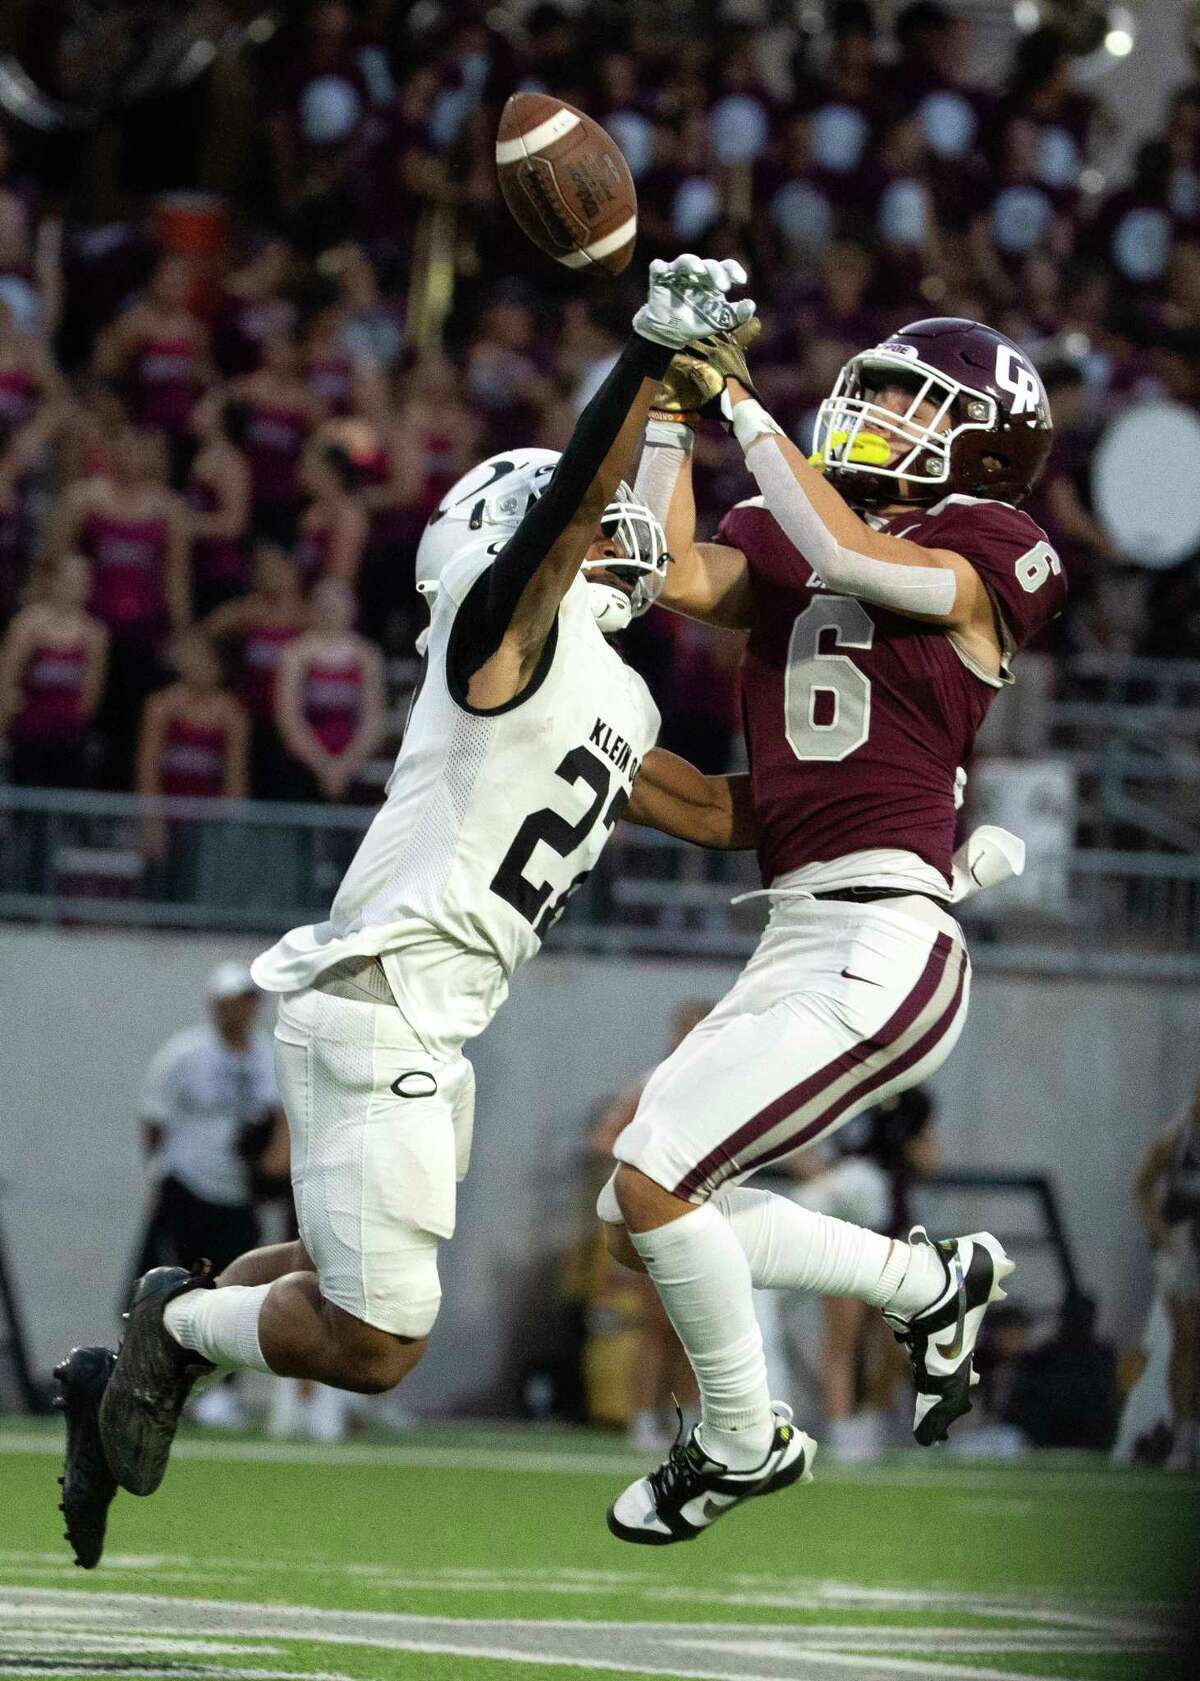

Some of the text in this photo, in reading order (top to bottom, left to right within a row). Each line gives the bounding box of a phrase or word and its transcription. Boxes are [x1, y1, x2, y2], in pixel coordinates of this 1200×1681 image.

[1014, 540, 1061, 593] 6
[784, 594, 875, 761] 6
[589, 716, 642, 788] KLEIN O
